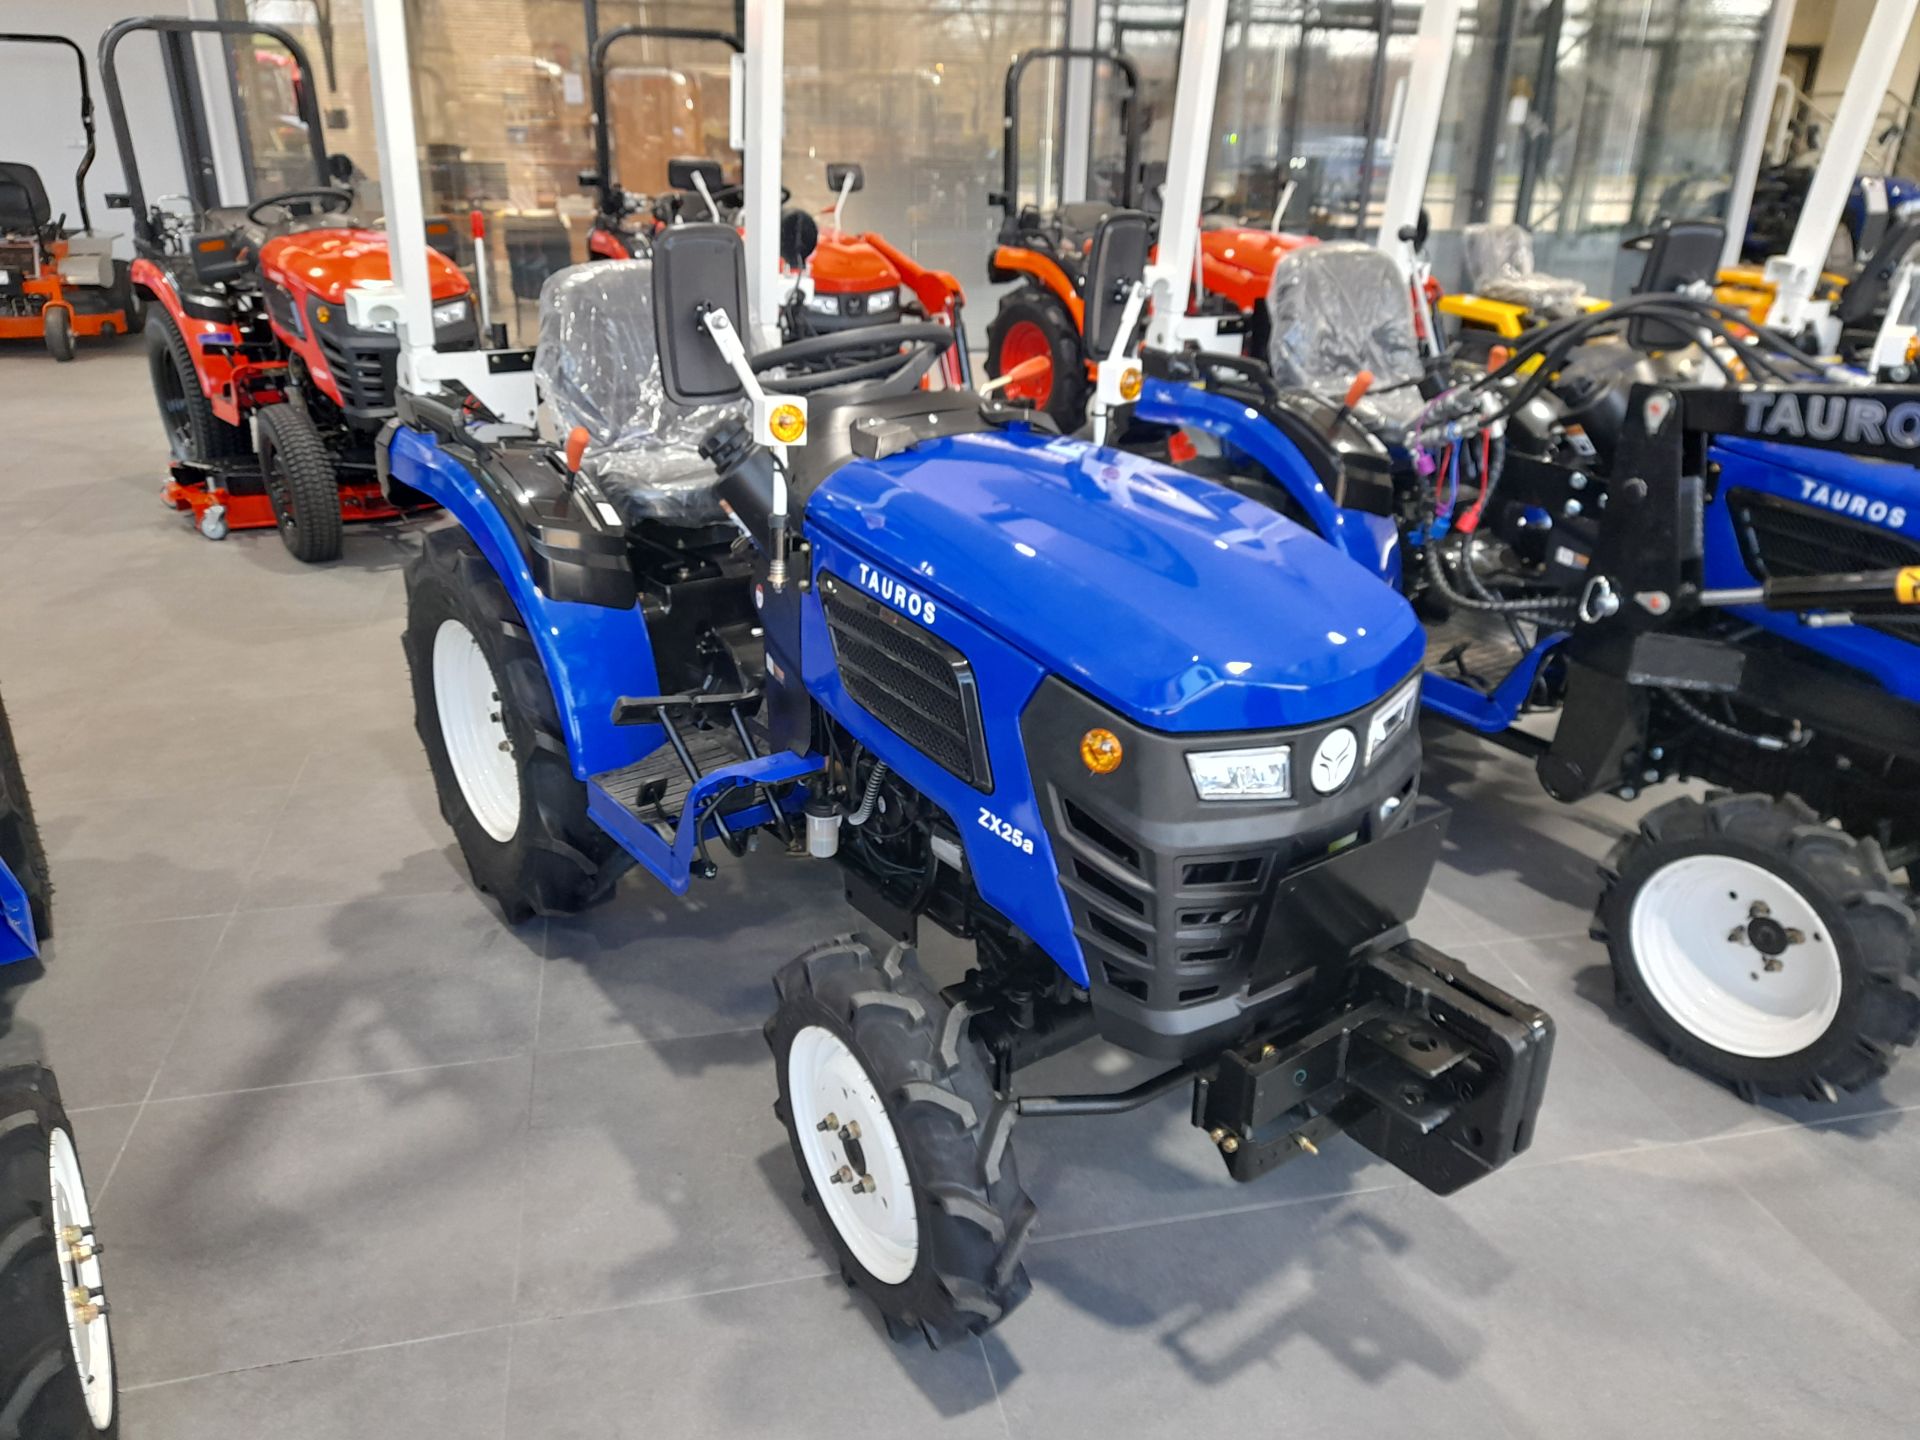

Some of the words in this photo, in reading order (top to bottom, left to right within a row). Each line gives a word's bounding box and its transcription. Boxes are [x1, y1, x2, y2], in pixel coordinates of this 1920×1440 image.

[1801, 477, 1907, 528] TAUROS
[859, 562, 936, 625] TAUROS
[978, 806, 1034, 856] ZX25a
